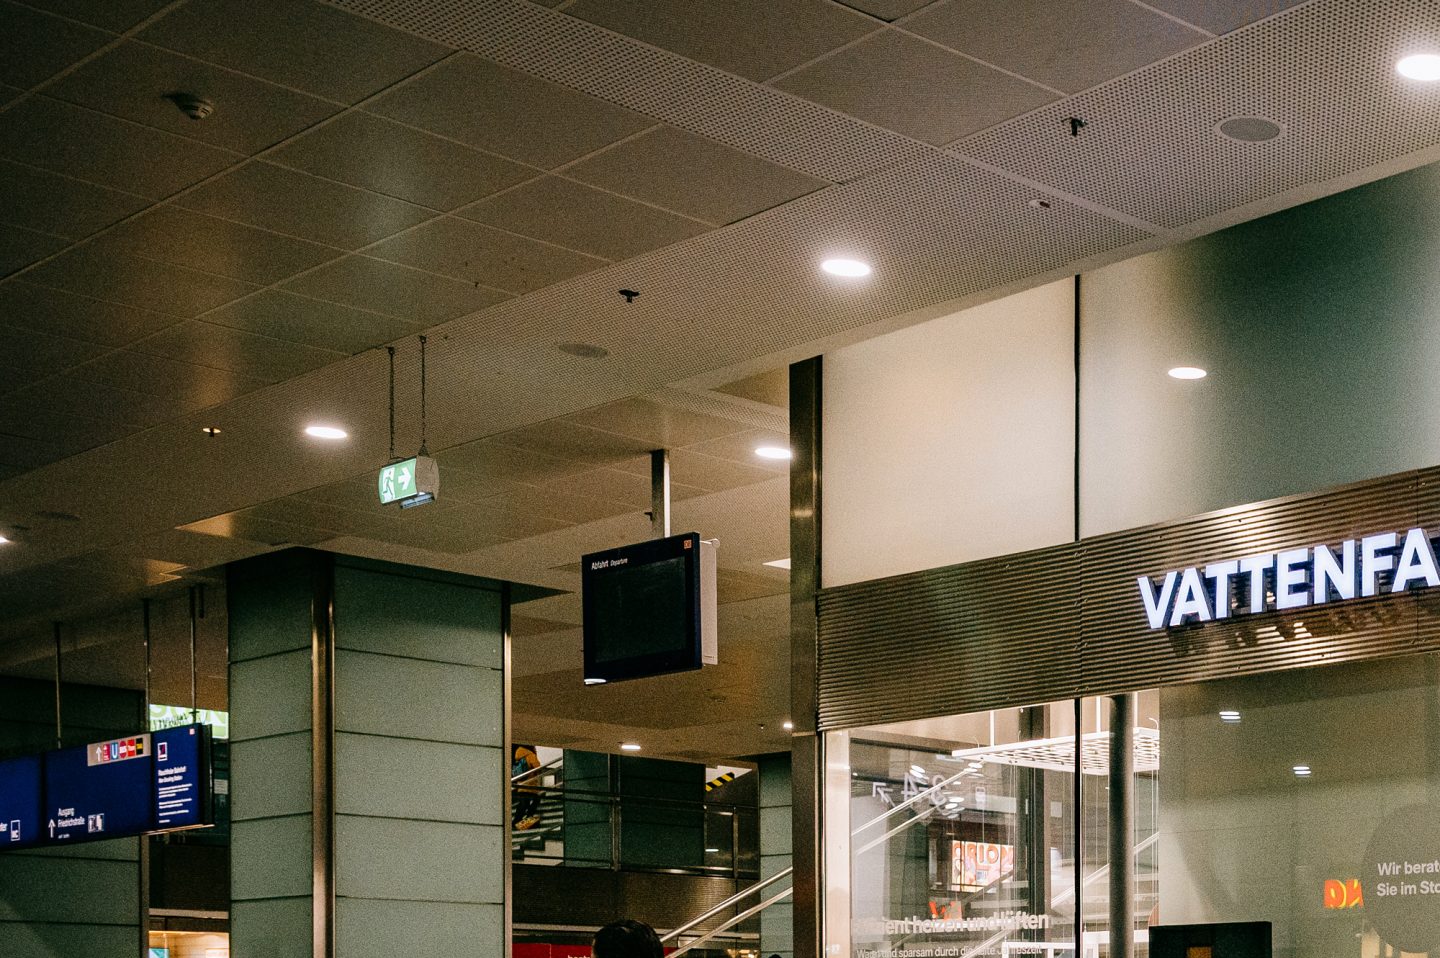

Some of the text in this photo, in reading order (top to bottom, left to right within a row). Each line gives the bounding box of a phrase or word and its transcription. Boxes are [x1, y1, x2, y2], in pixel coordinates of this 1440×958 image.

[591, 560, 609, 571] Abfahrt
[1377, 862, 1401, 876] Wir
[1376, 882, 1398, 897] Sie
[1400, 881, 1417, 895] im
[1000, 911, 1049, 930] lüften
[934, 945, 959, 957] durch
